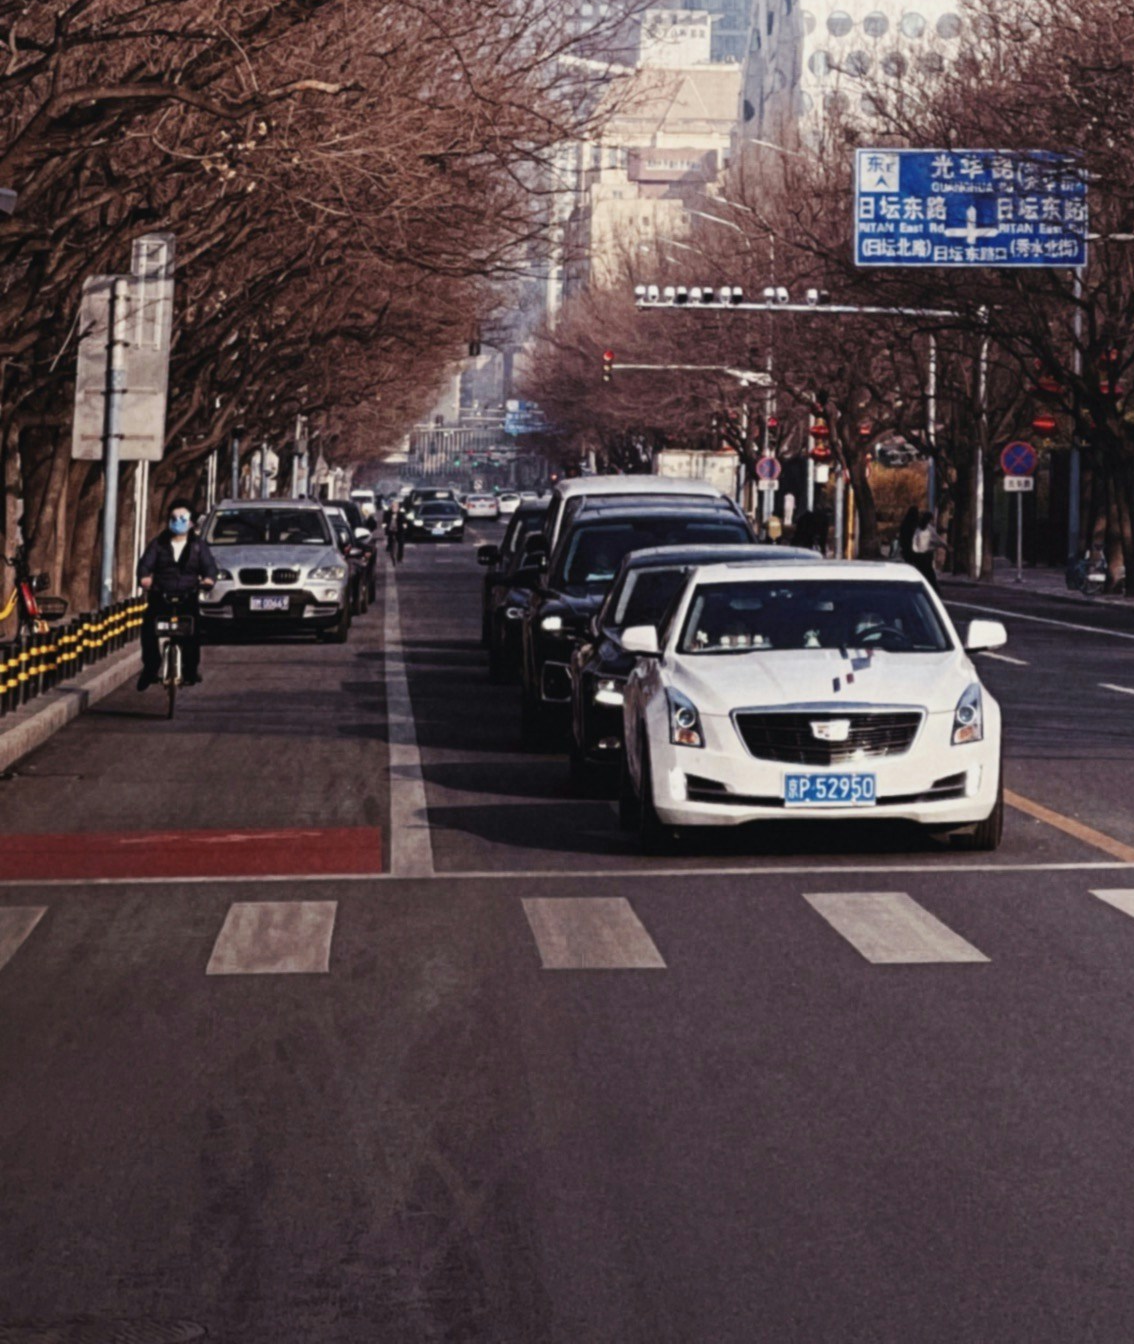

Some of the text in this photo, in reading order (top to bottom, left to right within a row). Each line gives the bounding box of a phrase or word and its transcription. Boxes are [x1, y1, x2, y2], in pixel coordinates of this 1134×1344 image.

[860, 196, 947, 221] 日坛东路
[997, 196, 1084, 221] 日坛东路
